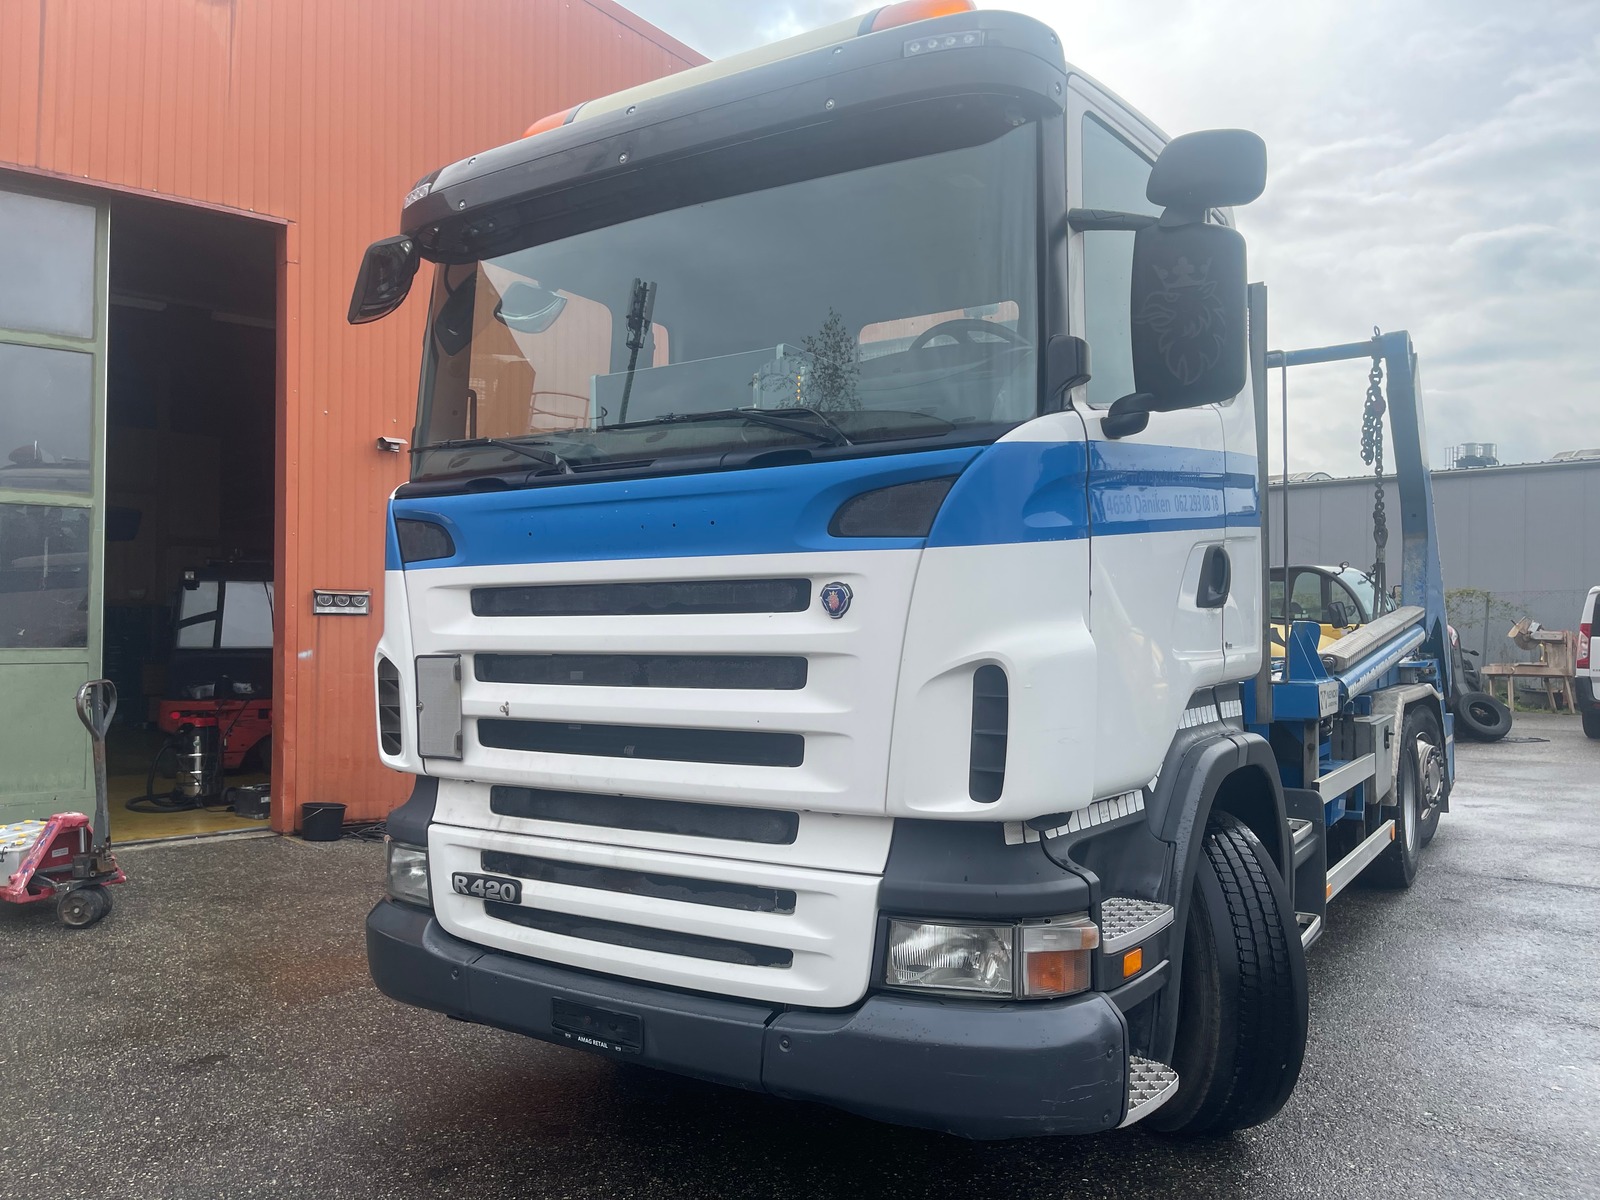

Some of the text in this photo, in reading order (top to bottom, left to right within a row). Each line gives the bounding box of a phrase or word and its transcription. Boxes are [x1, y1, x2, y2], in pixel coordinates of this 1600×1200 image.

[1106, 494, 1132, 515] 4658
[1134, 493, 1171, 514] Däniken
[1174, 494, 1187, 512] 062
[1190, 494, 1202, 512] 293
[578, 1036, 608, 1048] AMAG RETAIL
